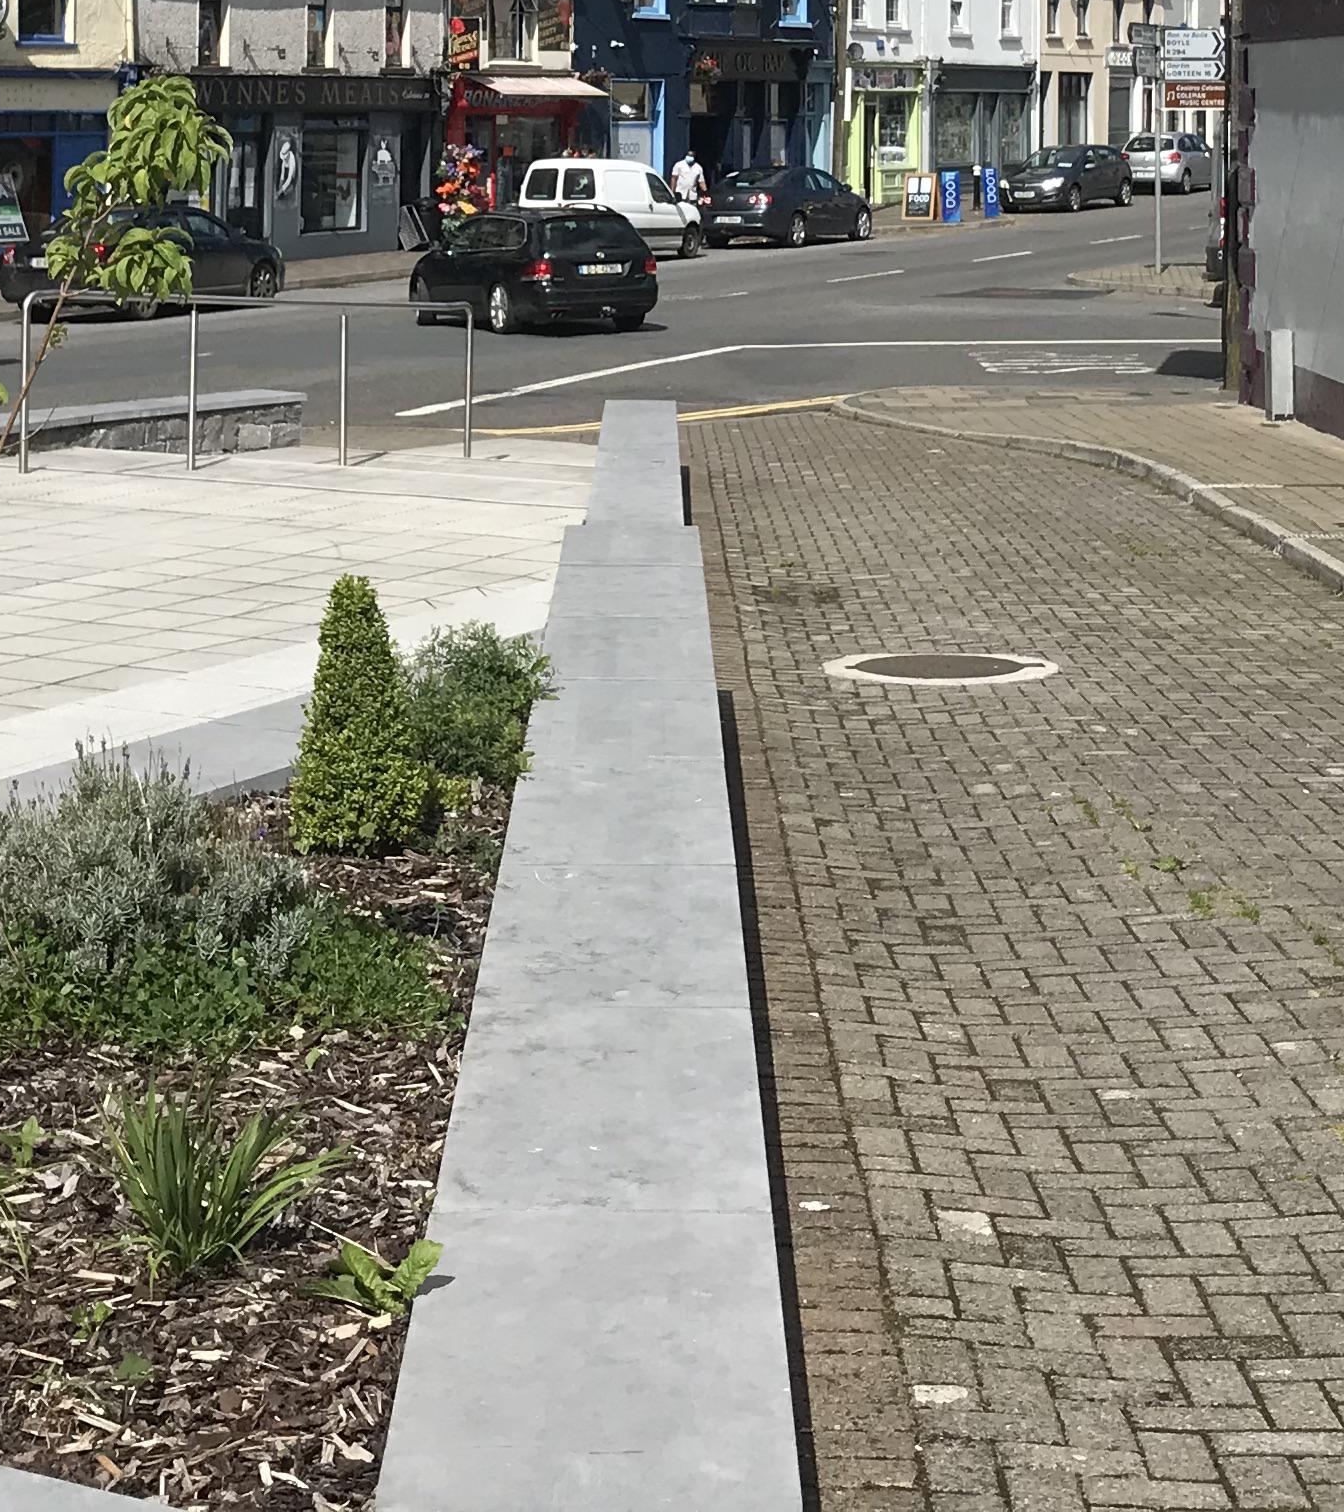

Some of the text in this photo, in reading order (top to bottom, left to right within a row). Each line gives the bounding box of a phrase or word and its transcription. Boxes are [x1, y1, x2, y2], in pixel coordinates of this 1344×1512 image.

[320, 82, 399, 105] MEATS
[945, 172, 957, 208] FOOD
[985, 168, 998, 204] FOOD
[908, 194, 930, 203] FOOD
[2, 225, 22, 236] SALE
